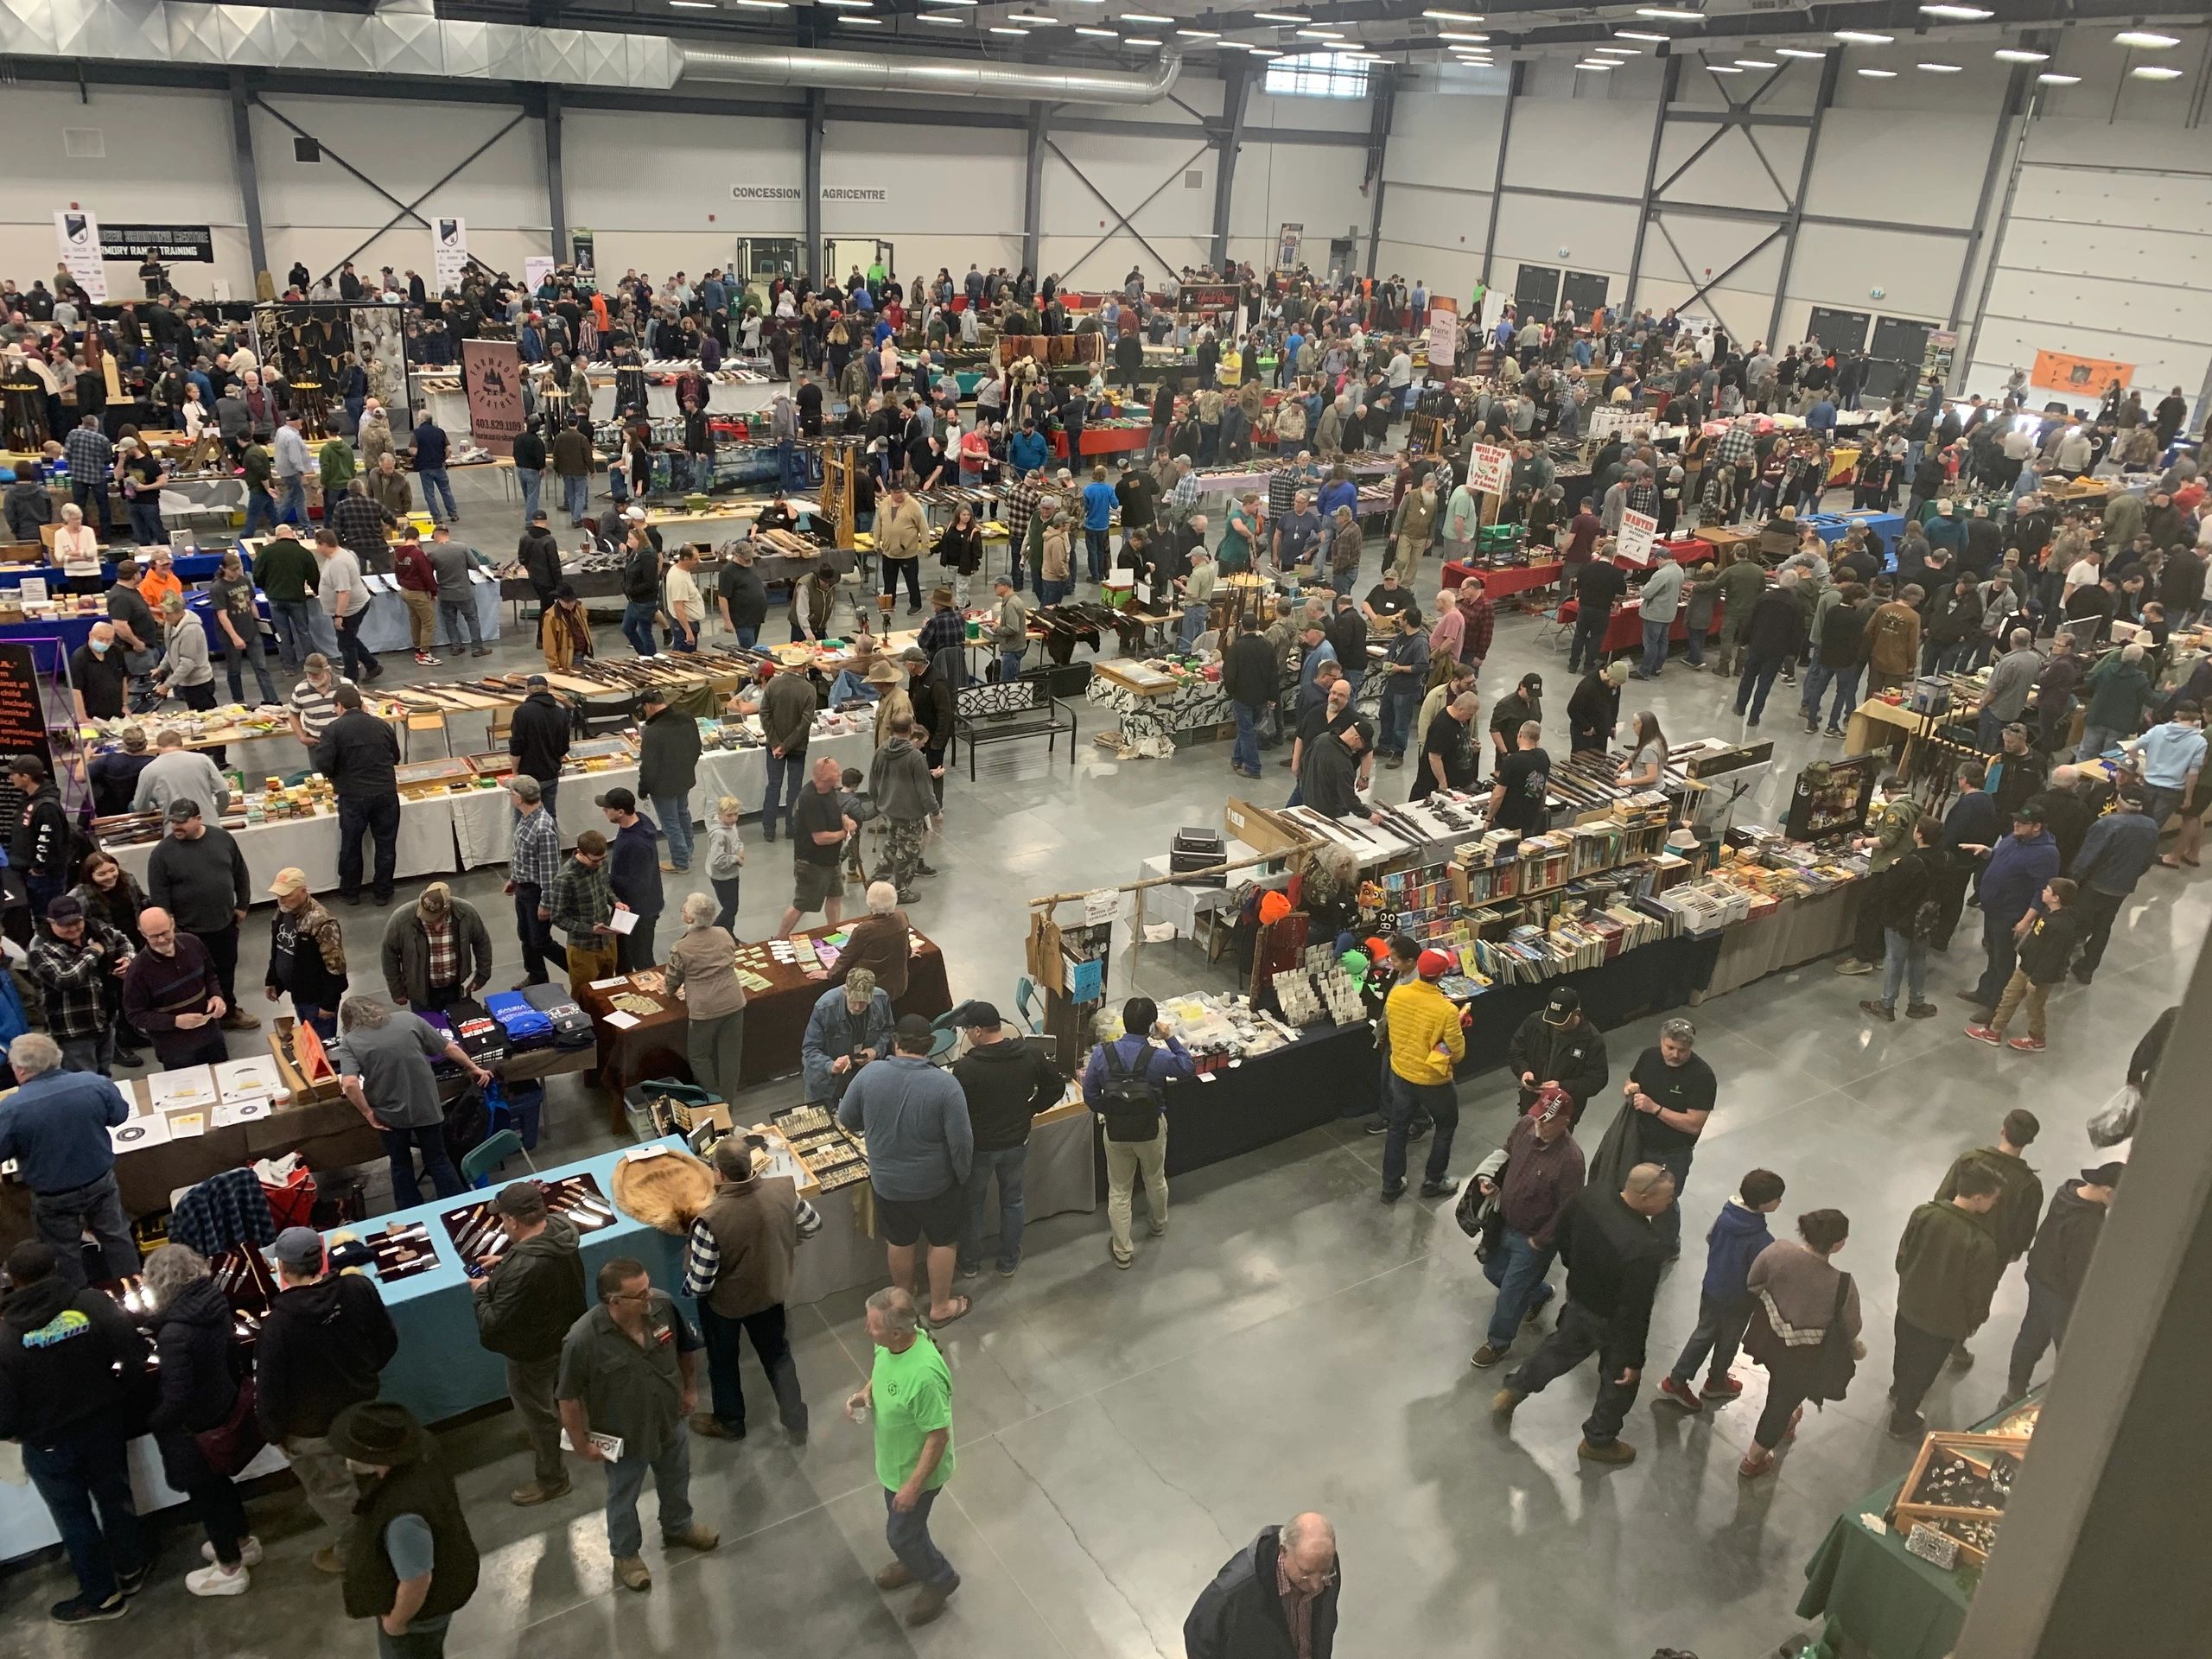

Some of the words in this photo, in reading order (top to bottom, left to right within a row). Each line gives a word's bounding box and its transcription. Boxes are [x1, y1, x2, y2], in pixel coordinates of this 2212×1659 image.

[733, 187, 801, 200] CONCESSION
[822, 188, 886, 200] AGRICENTRE
[173, 231, 209, 244] CENTRE
[99, 245, 129, 256] RMORY
[159, 246, 198, 257] TRAINING
[1431, 325, 1450, 335] Prairie
[469, 357, 516, 378] FARMBOY
[474, 390, 517, 409] LEATHER
[1479, 454, 1499, 464] CASH
[1624, 512, 1654, 531] WANTED
[1, 728, 43, 738] emotional
